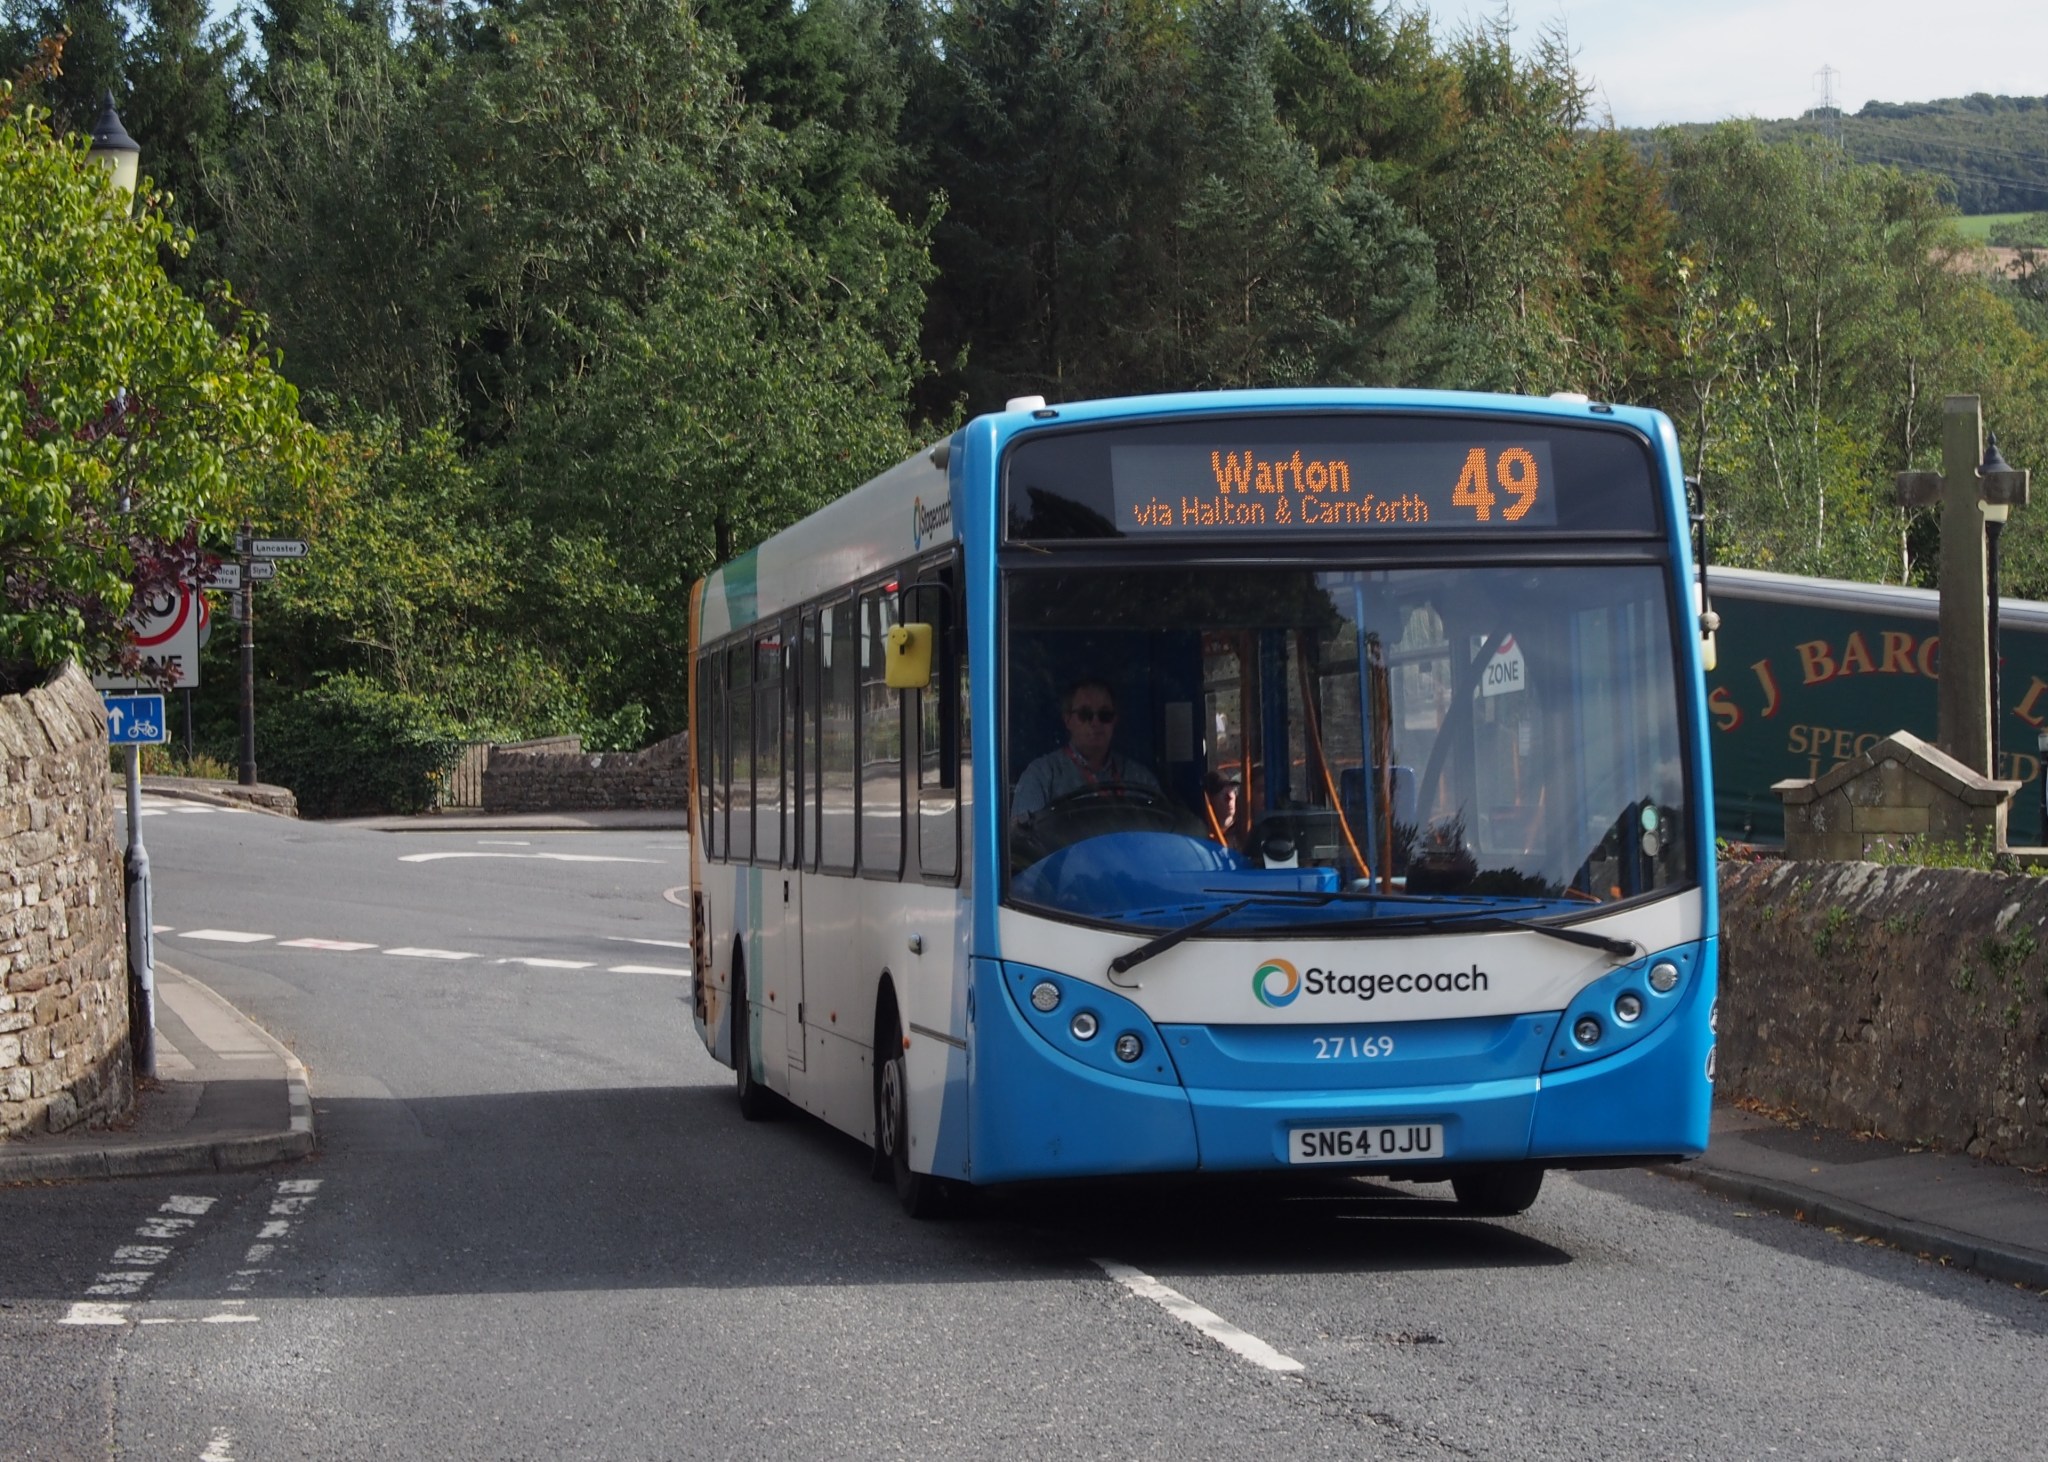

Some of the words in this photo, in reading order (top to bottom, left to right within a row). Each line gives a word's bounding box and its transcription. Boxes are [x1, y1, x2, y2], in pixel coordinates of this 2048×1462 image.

[1211, 449, 1350, 493] Warton
[1451, 447, 1540, 522] 49
[920, 491, 951, 540] Stagecoach
[1133, 496, 1173, 525] via
[1182, 496, 1266, 525] Halton
[1274, 495, 1293, 524] &
[1300, 494, 1430, 524] Carnforth
[256, 544, 298, 553] Lancaster
[1488, 661, 1519, 686] ZONE
[1304, 964, 1488, 1001] Stagecoach
[1313, 1036, 1394, 1059] 27169
[1301, 1130, 1371, 1157] SN64
[1379, 1127, 1432, 1154] OJU
